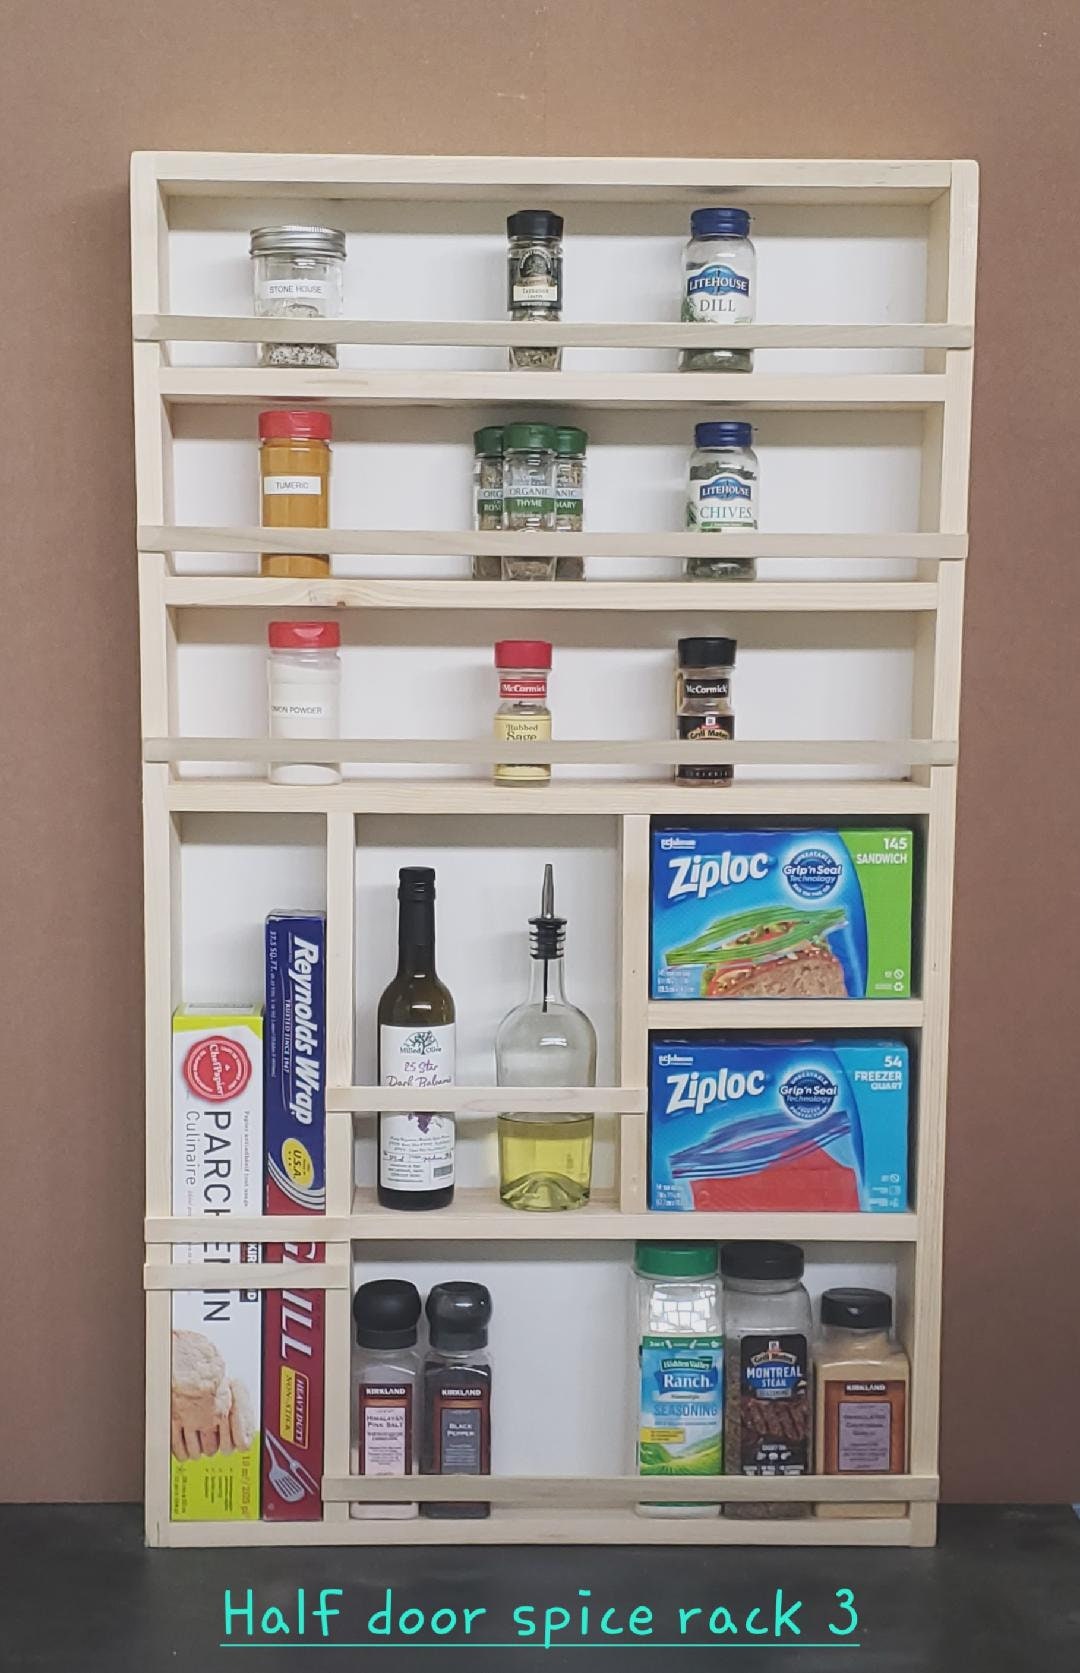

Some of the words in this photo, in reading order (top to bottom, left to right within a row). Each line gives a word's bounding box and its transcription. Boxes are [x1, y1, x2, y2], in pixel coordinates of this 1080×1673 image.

[269, 286, 293, 294] STONE
[296, 286, 322, 294] HOUSE
[689, 277, 748, 291] LITEHOUSE
[700, 299, 736, 313] DILL
[275, 481, 309, 489] TUMERIC
[509, 487, 550, 496] ORGANIC
[702, 487, 750, 497] LITEHOUSE
[516, 499, 543, 507] THYME
[700, 506, 752, 519] CHIVES
[686, 684, 728, 694] McCormick
[290, 706, 322, 714] POWDER
[883, 838, 908, 850] 145
[856, 853, 908, 865] SANDWICH
[668, 851, 769, 899] Ziploc
[816, 865, 842, 876] Seal
[288, 935, 320, 1056] Reynolds
[884, 1055, 902, 1068] 54
[854, 1070, 902, 1082] FREEZER
[289, 1055, 321, 1126] Wrap
[666, 1067, 765, 1115] Ziploc
[812, 1085, 837, 1096] Seal
[185, 1110, 201, 1186] Culinaire
[746, 1366, 803, 1379] MONTREAL
[663, 1373, 710, 1388] Ranch
[366, 1387, 406, 1395] KIRKLAND
[846, 1383, 886, 1391] KIRKLAND
[296, 1379, 305, 1413] HEAVY
[655, 1404, 718, 1417] SEASONING
